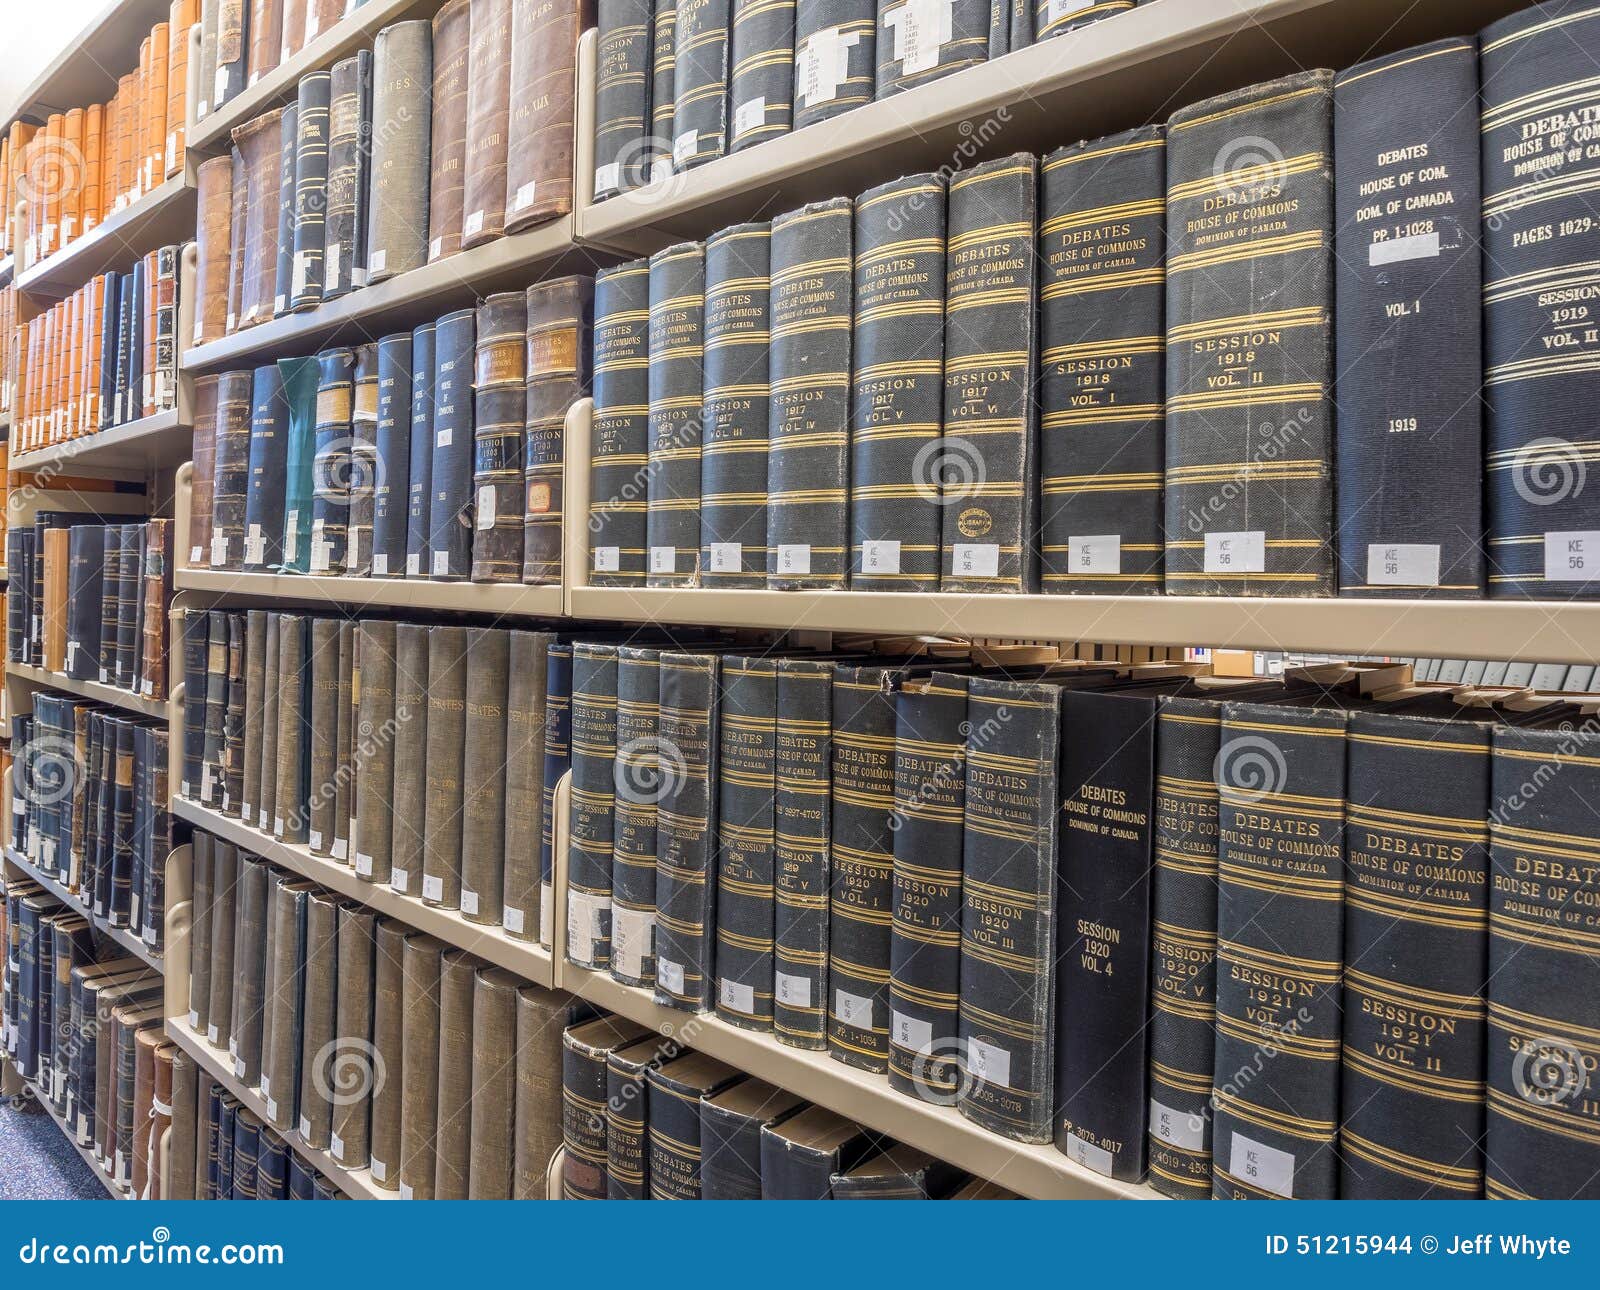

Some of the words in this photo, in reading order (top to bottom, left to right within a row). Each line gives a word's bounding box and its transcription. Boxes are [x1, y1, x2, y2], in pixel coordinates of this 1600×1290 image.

[1377, 143, 1428, 166] DEBATES
[1503, 137, 1542, 162] HOUSE
[1550, 132, 1567, 148] OF
[1514, 154, 1565, 177] DOMINION
[1360, 179, 1396, 196] HOUSE
[1399, 172, 1414, 187] OF
[1418, 166, 1448, 182] COM.
[1203, 184, 1282, 213] DEBATES
[1356, 206, 1383, 222] DOM.
[1387, 201, 1401, 215] OF
[1405, 191, 1454, 211] CANADA
[1187, 216, 1222, 233] HOUSE
[1225, 211, 1239, 224] OF
[1243, 199, 1299, 221] COMMONS
[1062, 223, 1131, 247] DEBATES
[1195, 232, 1235, 246] DOMINION
[1251, 221, 1288, 234] CANADA
[1373, 230, 1390, 243] PP.
[1395, 220, 1433, 240] 1-1028
[1513, 224, 1553, 247] PAGES
[955, 244, 1011, 265] DEBATES
[1050, 249, 1078, 265] HOUSE
[1081, 247, 1094, 259] OF
[1097, 238, 1146, 256] COMMONS
[865, 259, 916, 279] DEBATES
[968, 265, 979, 276] OF
[981, 259, 1025, 273] COMMONS
[1104, 257, 1136, 268] CANADA
[780, 278, 824, 297] DEBATES
[888, 273, 928, 287] COMMONS
[986, 276, 1014, 285] CANADA
[800, 291, 835, 304] COMMONS
[1538, 286, 1600, 307] SESSION
[727, 308, 762, 318] COMMONS
[1552, 306, 1588, 323] 1919
[1195, 331, 1281, 353] SESSION
[1542, 332, 1579, 349] VOL.
[1057, 357, 1133, 375] SESSION
[1218, 351, 1256, 365] 1918
[859, 378, 916, 395] SESSION
[946, 370, 1011, 387] SESSION
[1077, 373, 1111, 386] 1918
[1207, 373, 1241, 388] VOL.
[774, 391, 825, 405] SESSION
[872, 394, 894, 405] 1917
[962, 387, 988, 398] 1917
[1071, 393, 1100, 407] VOL.
[785, 405, 806, 415] 1917
[1389, 418, 1417, 433] 1919
[1081, 544, 1091, 555] KE
[1219, 540, 1231, 551] KE
[1568, 540, 1584, 553] KE
[1081, 556, 1091, 566] 56
[1219, 553, 1231, 564] 56
[1384, 550, 1398, 561] KE
[1568, 556, 1584, 568] 56
[1384, 563, 1398, 574] 56
[739, 748, 774, 759] COMMONS
[838, 749, 887, 765] DEBATES
[850, 767, 858, 775] OF
[897, 756, 951, 774] DEBATES
[866, 782, 891, 791] CANADA
[970, 770, 1028, 789] DEBATES
[985, 787, 995, 800] OF
[998, 791, 1041, 807] COMMONS
[1081, 785, 1126, 806] DEBATES
[1064, 800, 1088, 815] HOUSE
[1091, 806, 1101, 817] OF
[1103, 808, 1146, 825] COMMONS
[1156, 797, 1217, 817] DEBATES
[1069, 818, 1099, 833] DOMINION
[1112, 828, 1138, 841] CANADA
[1235, 812, 1320, 837] DEBATES
[1182, 842, 1216, 854] CANADA
[1221, 829, 1254, 847] HOUSE
[1258, 836, 1273, 850] OF
[1277, 839, 1340, 858] COMMONS
[1366, 833, 1464, 861] DEBATES
[834, 860, 888, 880] SESSION
[1227, 849, 1269, 865] DOMINION
[1286, 861, 1327, 874] CANADA
[1350, 851, 1388, 870] HOUSE
[1393, 860, 1410, 875] OF
[1415, 863, 1485, 885] COMMONS
[845, 876, 870, 888] 1920
[893, 875, 949, 898] SESSION
[1359, 873, 1405, 893] DOMINION
[1408, 883, 1422, 895] OF
[1425, 886, 1471, 902] CANADA
[1495, 875, 1540, 898] HOUSE
[1547, 885, 1568, 902] OF
[841, 890, 867, 904] VOL.
[903, 892, 929, 906] 1920
[967, 896, 1023, 920] SESSION
[1504, 899, 1560, 921] DOMINION
[1565, 912, 1580, 923] OF
[981, 914, 1009, 930] 1920
[1077, 919, 1120, 944] SESSION
[1085, 938, 1110, 958] 1920
[1153, 940, 1214, 964] SESSION
[1106, 963, 1113, 976] 4
[1162, 958, 1199, 976] 1920
[1231, 965, 1315, 998] SESSION
[1248, 987, 1292, 1009] 1921
[1362, 998, 1457, 1035] SESSION
[1382, 1024, 1431, 1047] 1921
[1375, 1042, 1415, 1066] VOL.
[1425, 1057, 1441, 1072] II
[1064, 1118, 1075, 1134] PP.
[1160, 1112, 1170, 1125] KE
[1160, 1126, 1170, 1137] 56
[653, 1148, 692, 1172] DEBATES
[1246, 1150, 1258, 1163] KE
[1246, 1164, 1257, 1177] 56
